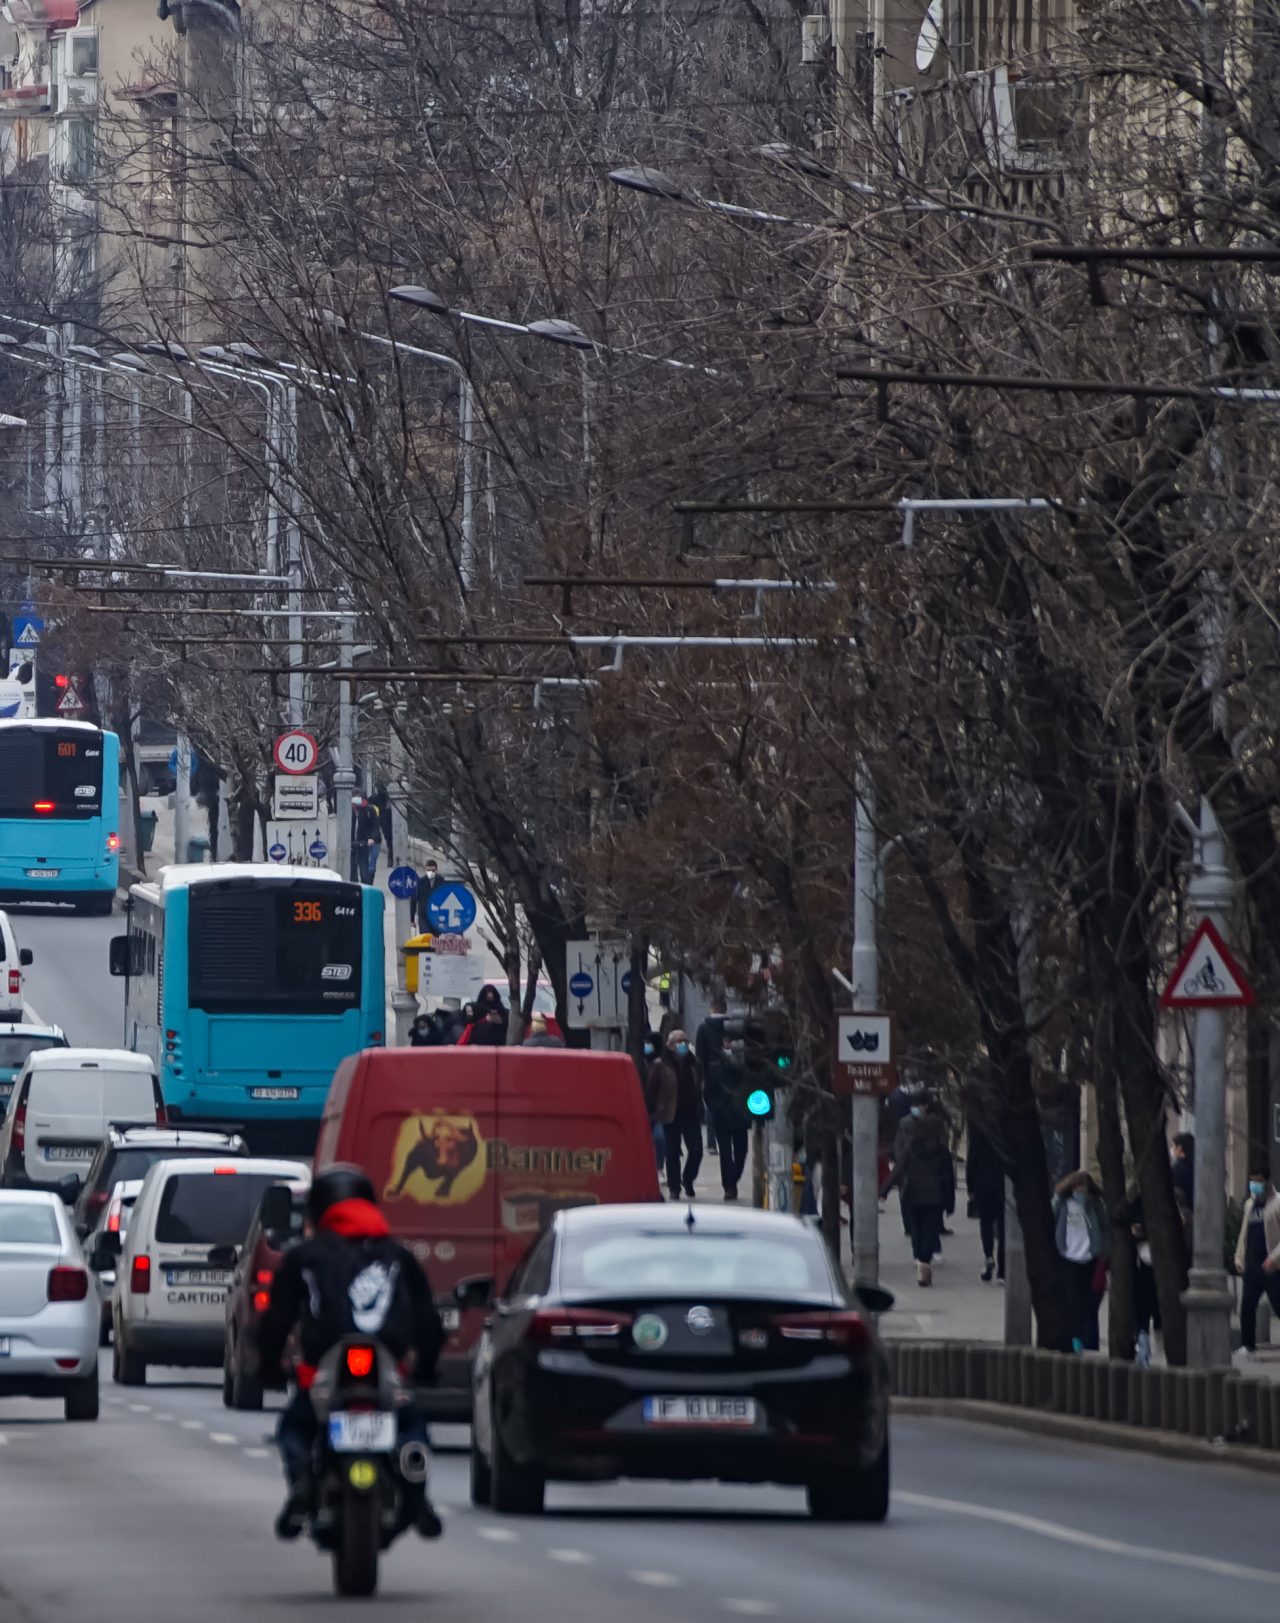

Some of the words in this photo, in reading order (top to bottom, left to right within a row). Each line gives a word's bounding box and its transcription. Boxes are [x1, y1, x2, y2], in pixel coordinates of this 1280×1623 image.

[58, 743, 76, 756] 601
[285, 743, 307, 763] 40
[294, 902, 321, 921] 336
[335, 906, 355, 916] 6414
[323, 991, 355, 999] OTOKAR
[847, 1064, 882, 1076] Teatrul
[484, 1137, 611, 1174] Banner
